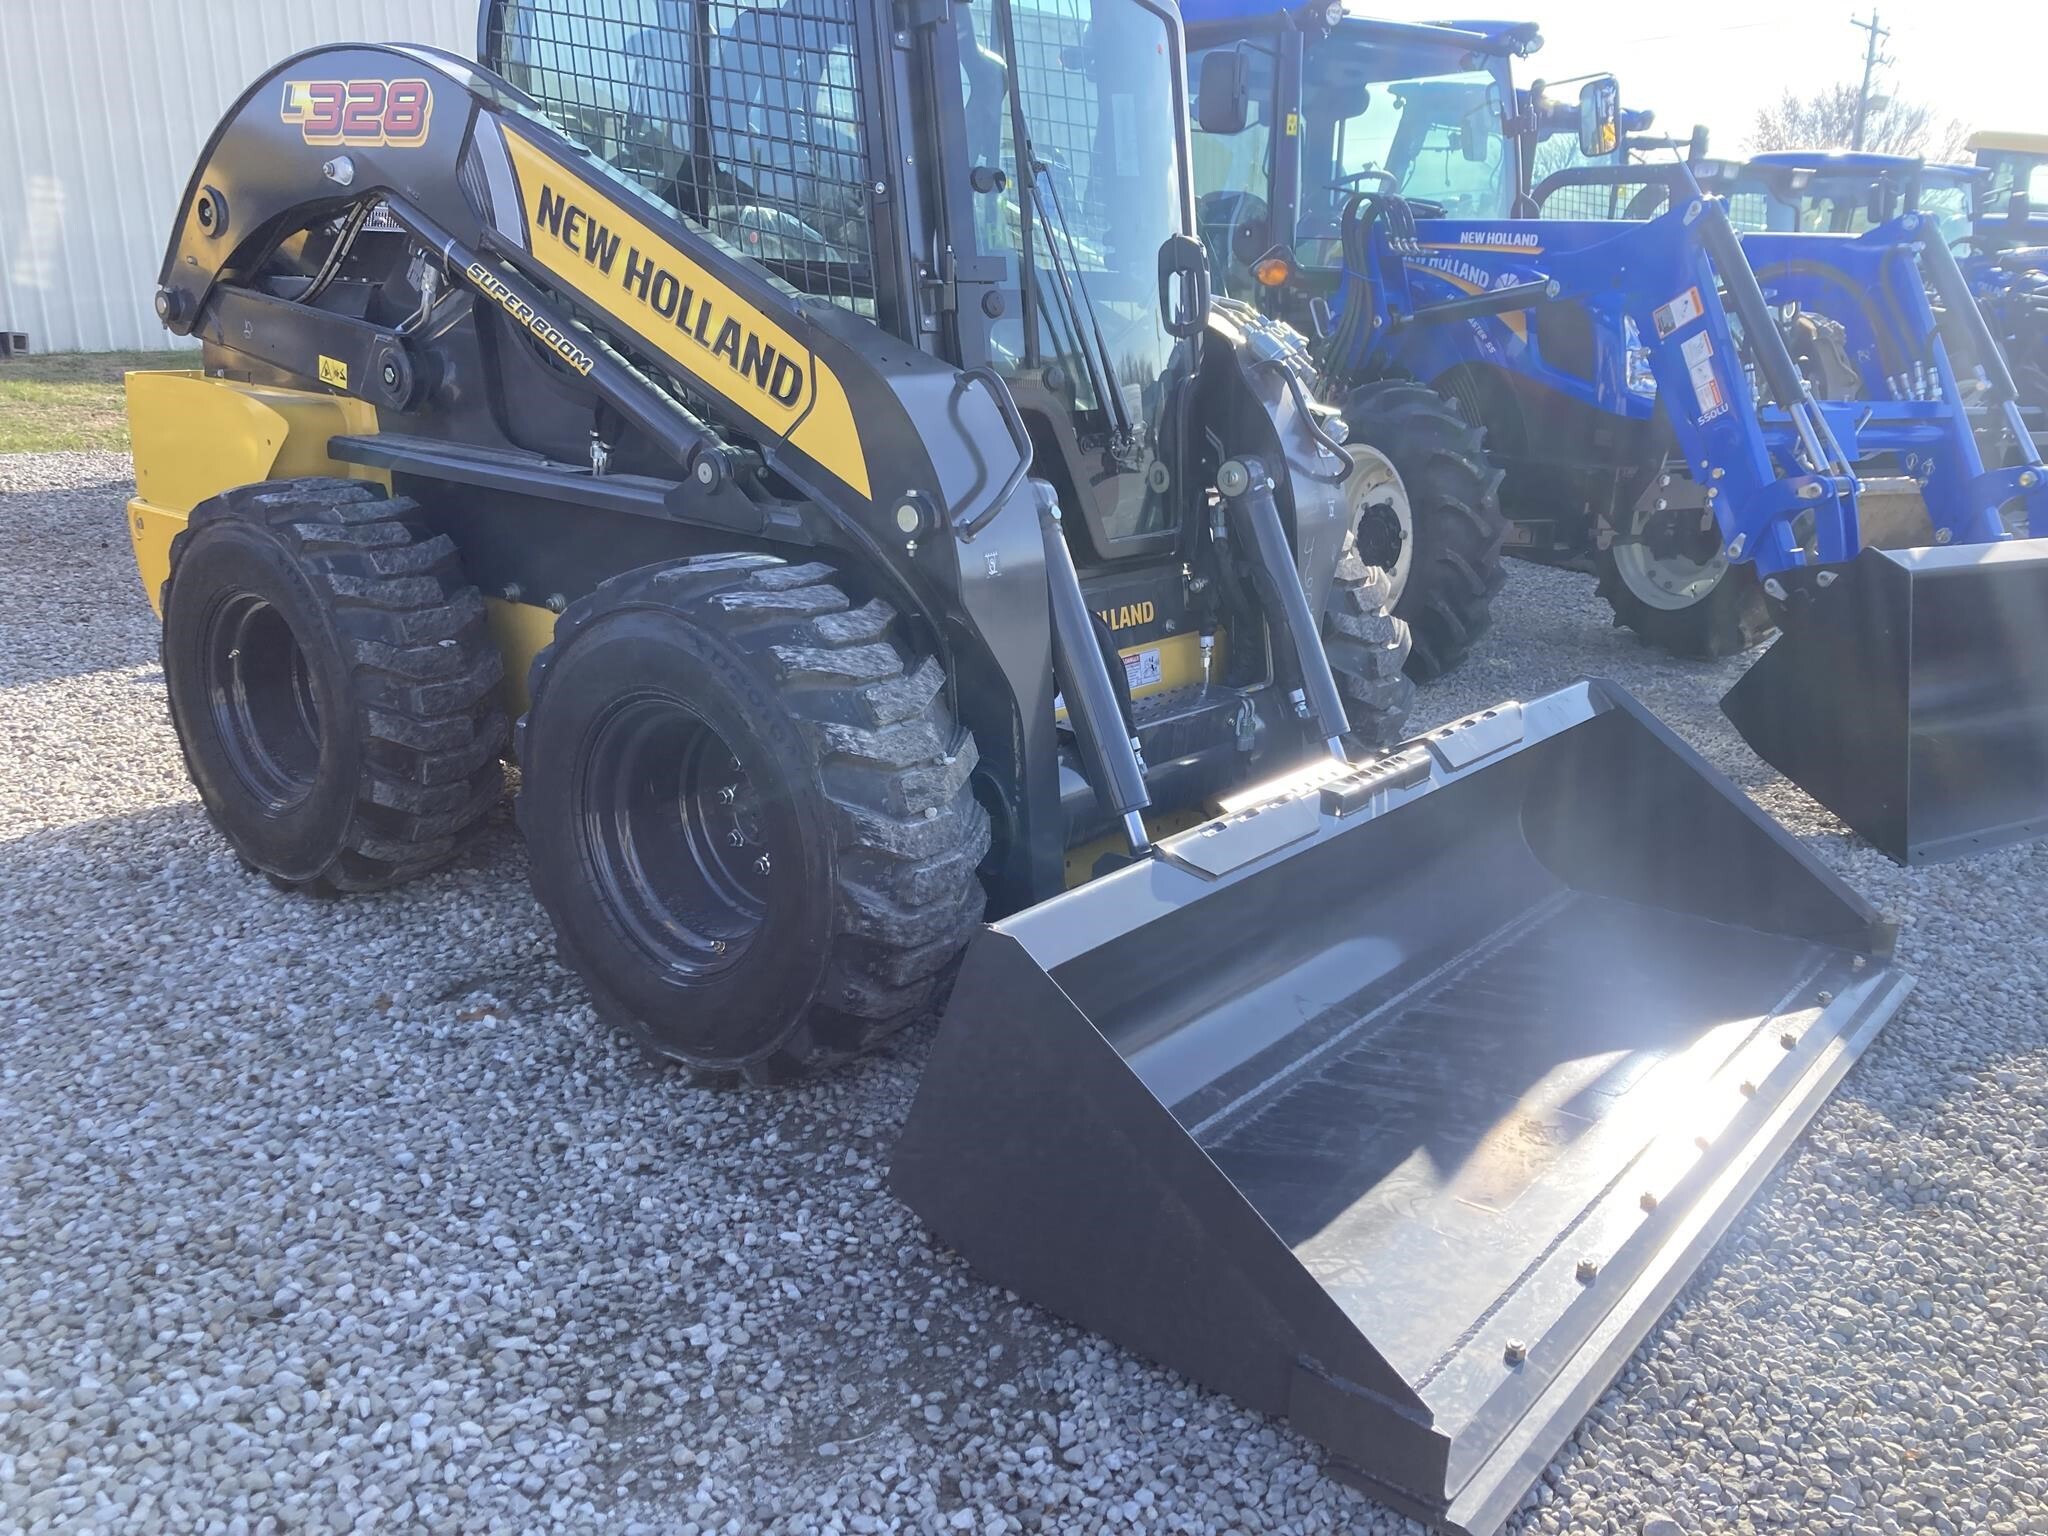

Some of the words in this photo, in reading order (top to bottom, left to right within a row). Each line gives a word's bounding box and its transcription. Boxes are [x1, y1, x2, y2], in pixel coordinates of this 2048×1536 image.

[281, 78, 433, 148] L328
[1460, 231, 1485, 244] NEW
[1486, 232, 1539, 247] HOLLAND
[467, 263, 534, 327] SUPER
[530, 316, 594, 376] BOOM
[536, 183, 622, 277] NEW
[622, 245, 805, 410] HOLLAND
